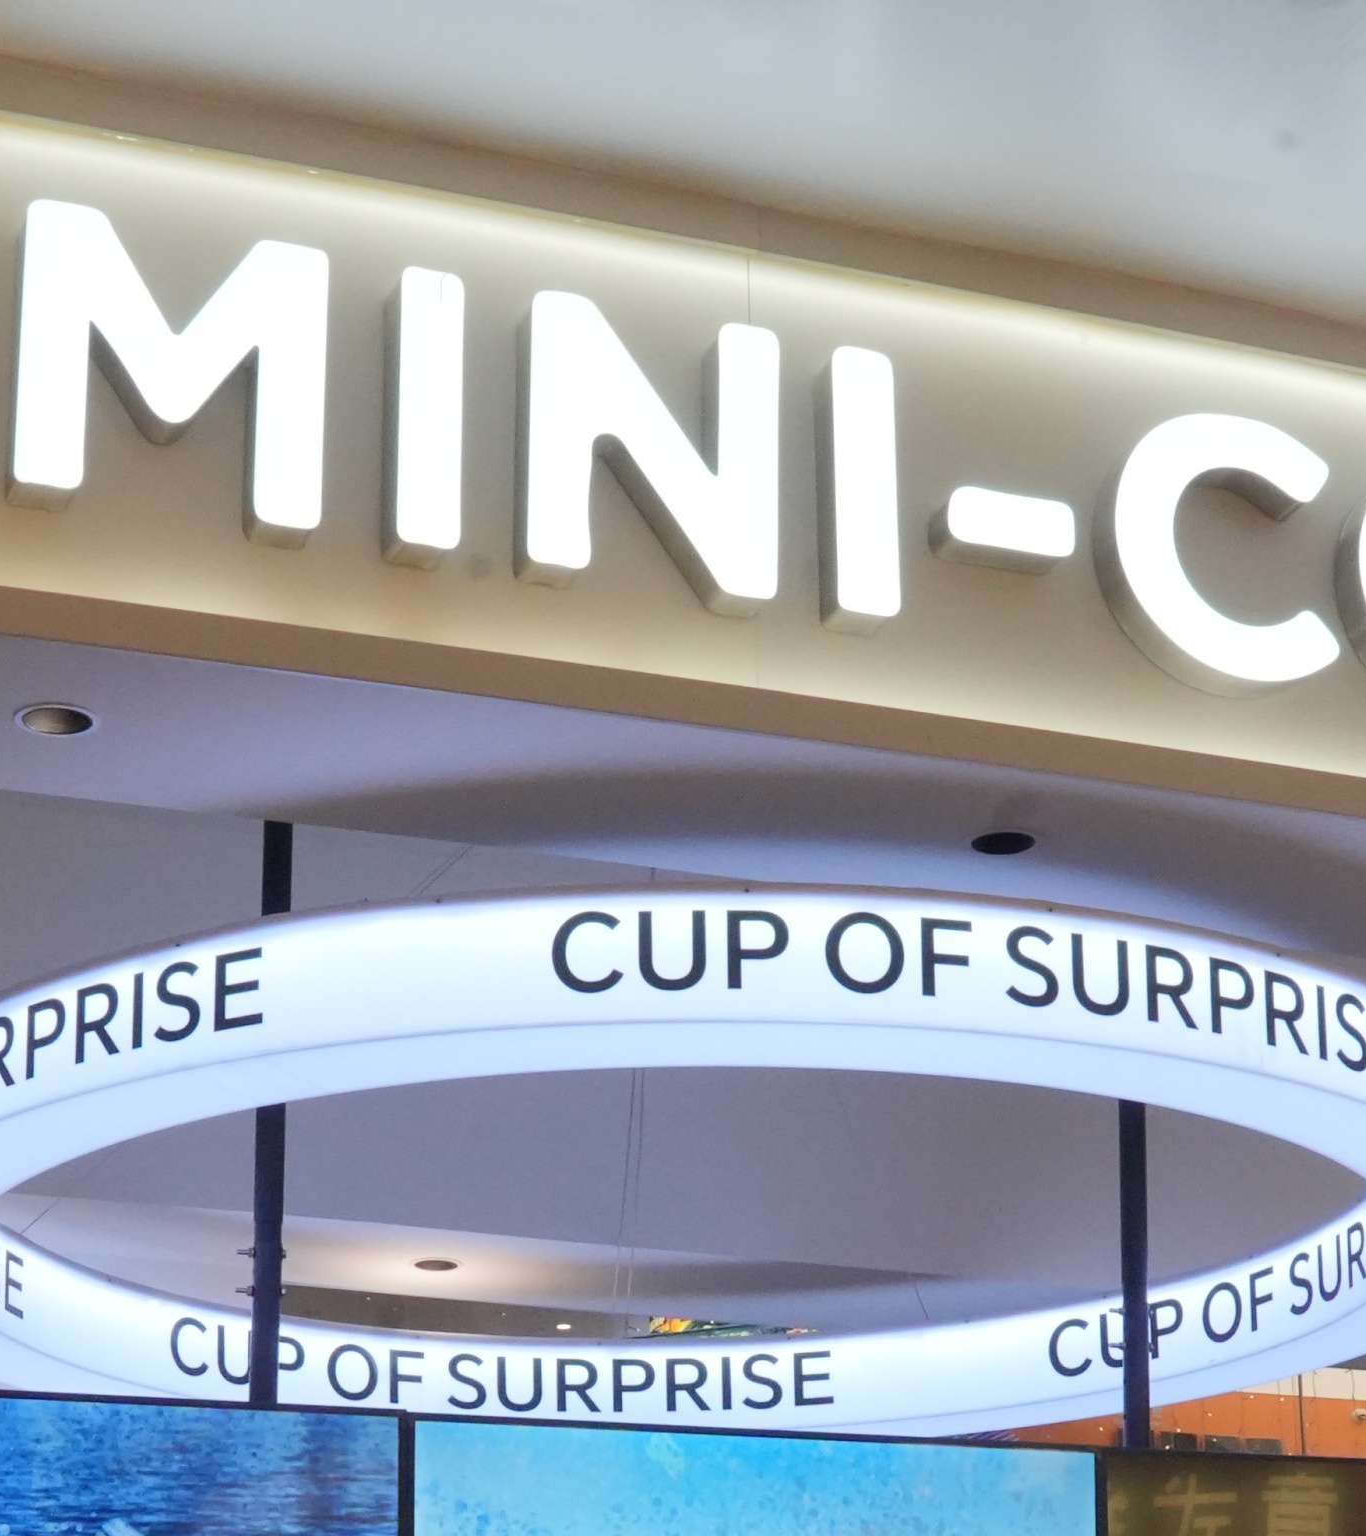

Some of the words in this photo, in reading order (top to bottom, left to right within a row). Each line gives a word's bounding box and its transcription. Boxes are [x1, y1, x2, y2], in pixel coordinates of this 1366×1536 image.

[550, 908, 790, 994] CUP
[824, 910, 974, 997] OF
[1201, 1264, 1274, 1344] OF
[326, 1342, 426, 1405] OF
[446, 1348, 835, 1414] SURPRISE
